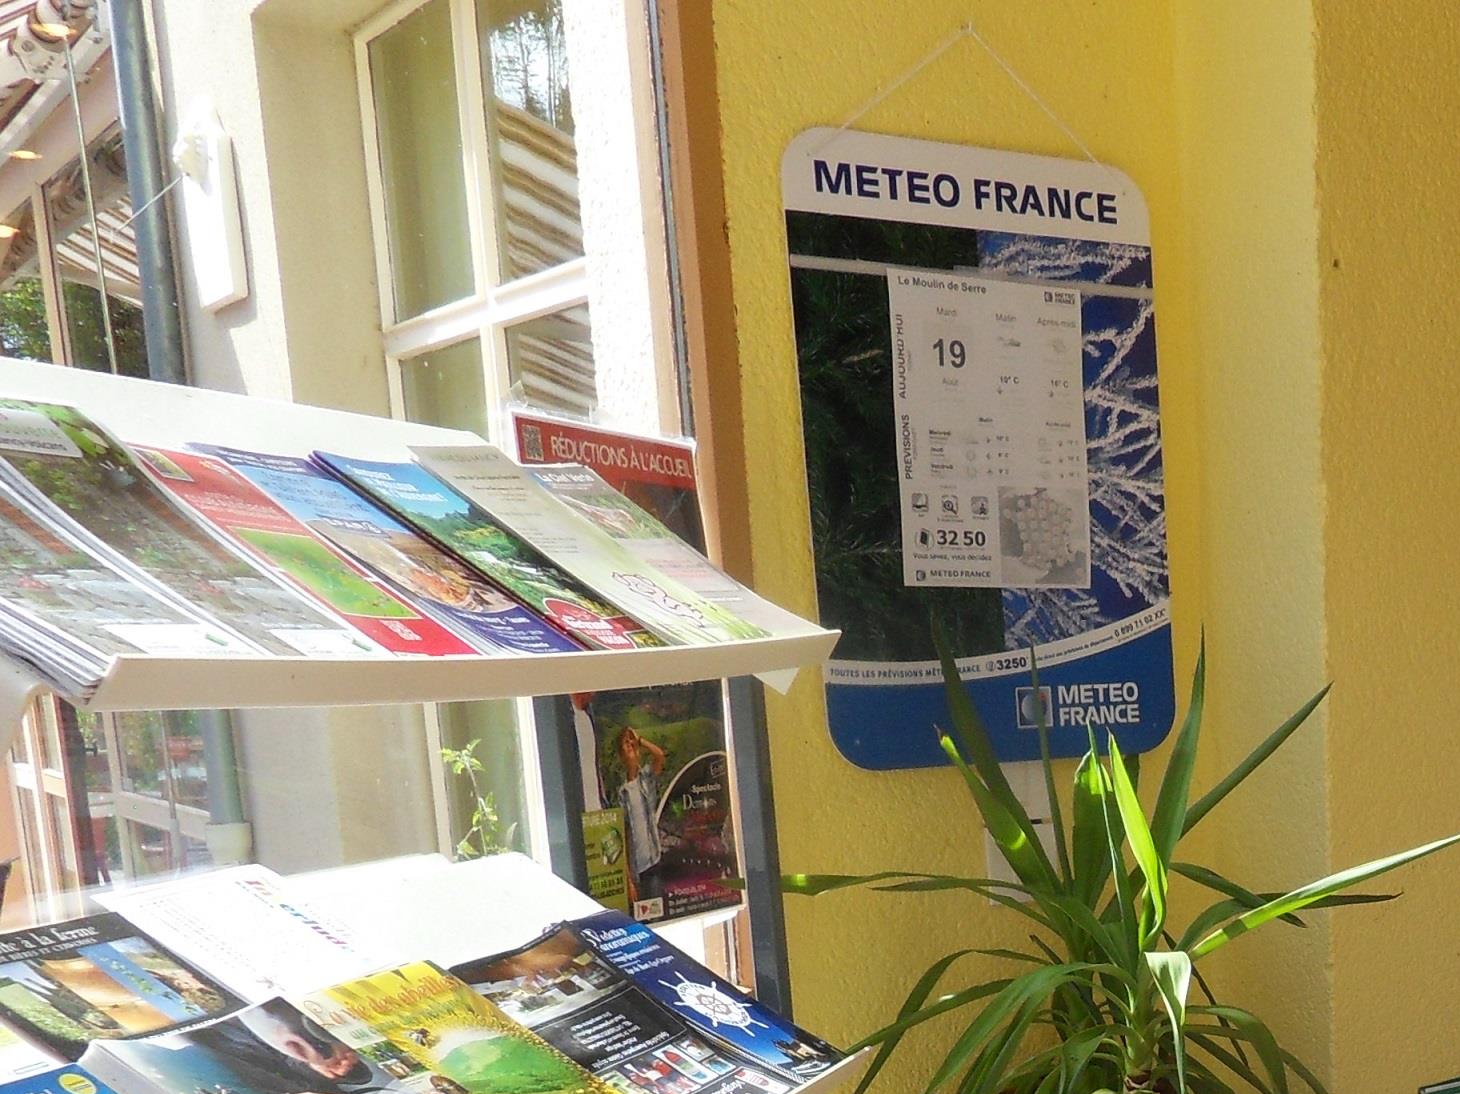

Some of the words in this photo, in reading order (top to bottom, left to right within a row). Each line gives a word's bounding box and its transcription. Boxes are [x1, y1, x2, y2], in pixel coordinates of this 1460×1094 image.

[813, 159, 960, 208] METEO
[973, 178, 1118, 225] FRANCE
[912, 277, 945, 290] Moulin
[961, 282, 987, 294] Serre
[933, 338, 966, 369] 19
[550, 432, 628, 468] RÉDUCTIONS
[640, 453, 693, 478] L'ACCUEIL
[878, 666, 923, 679] PRÉVISIONS
[1057, 681, 1139, 705] METEO
[1058, 703, 1140, 726] FRANCE
